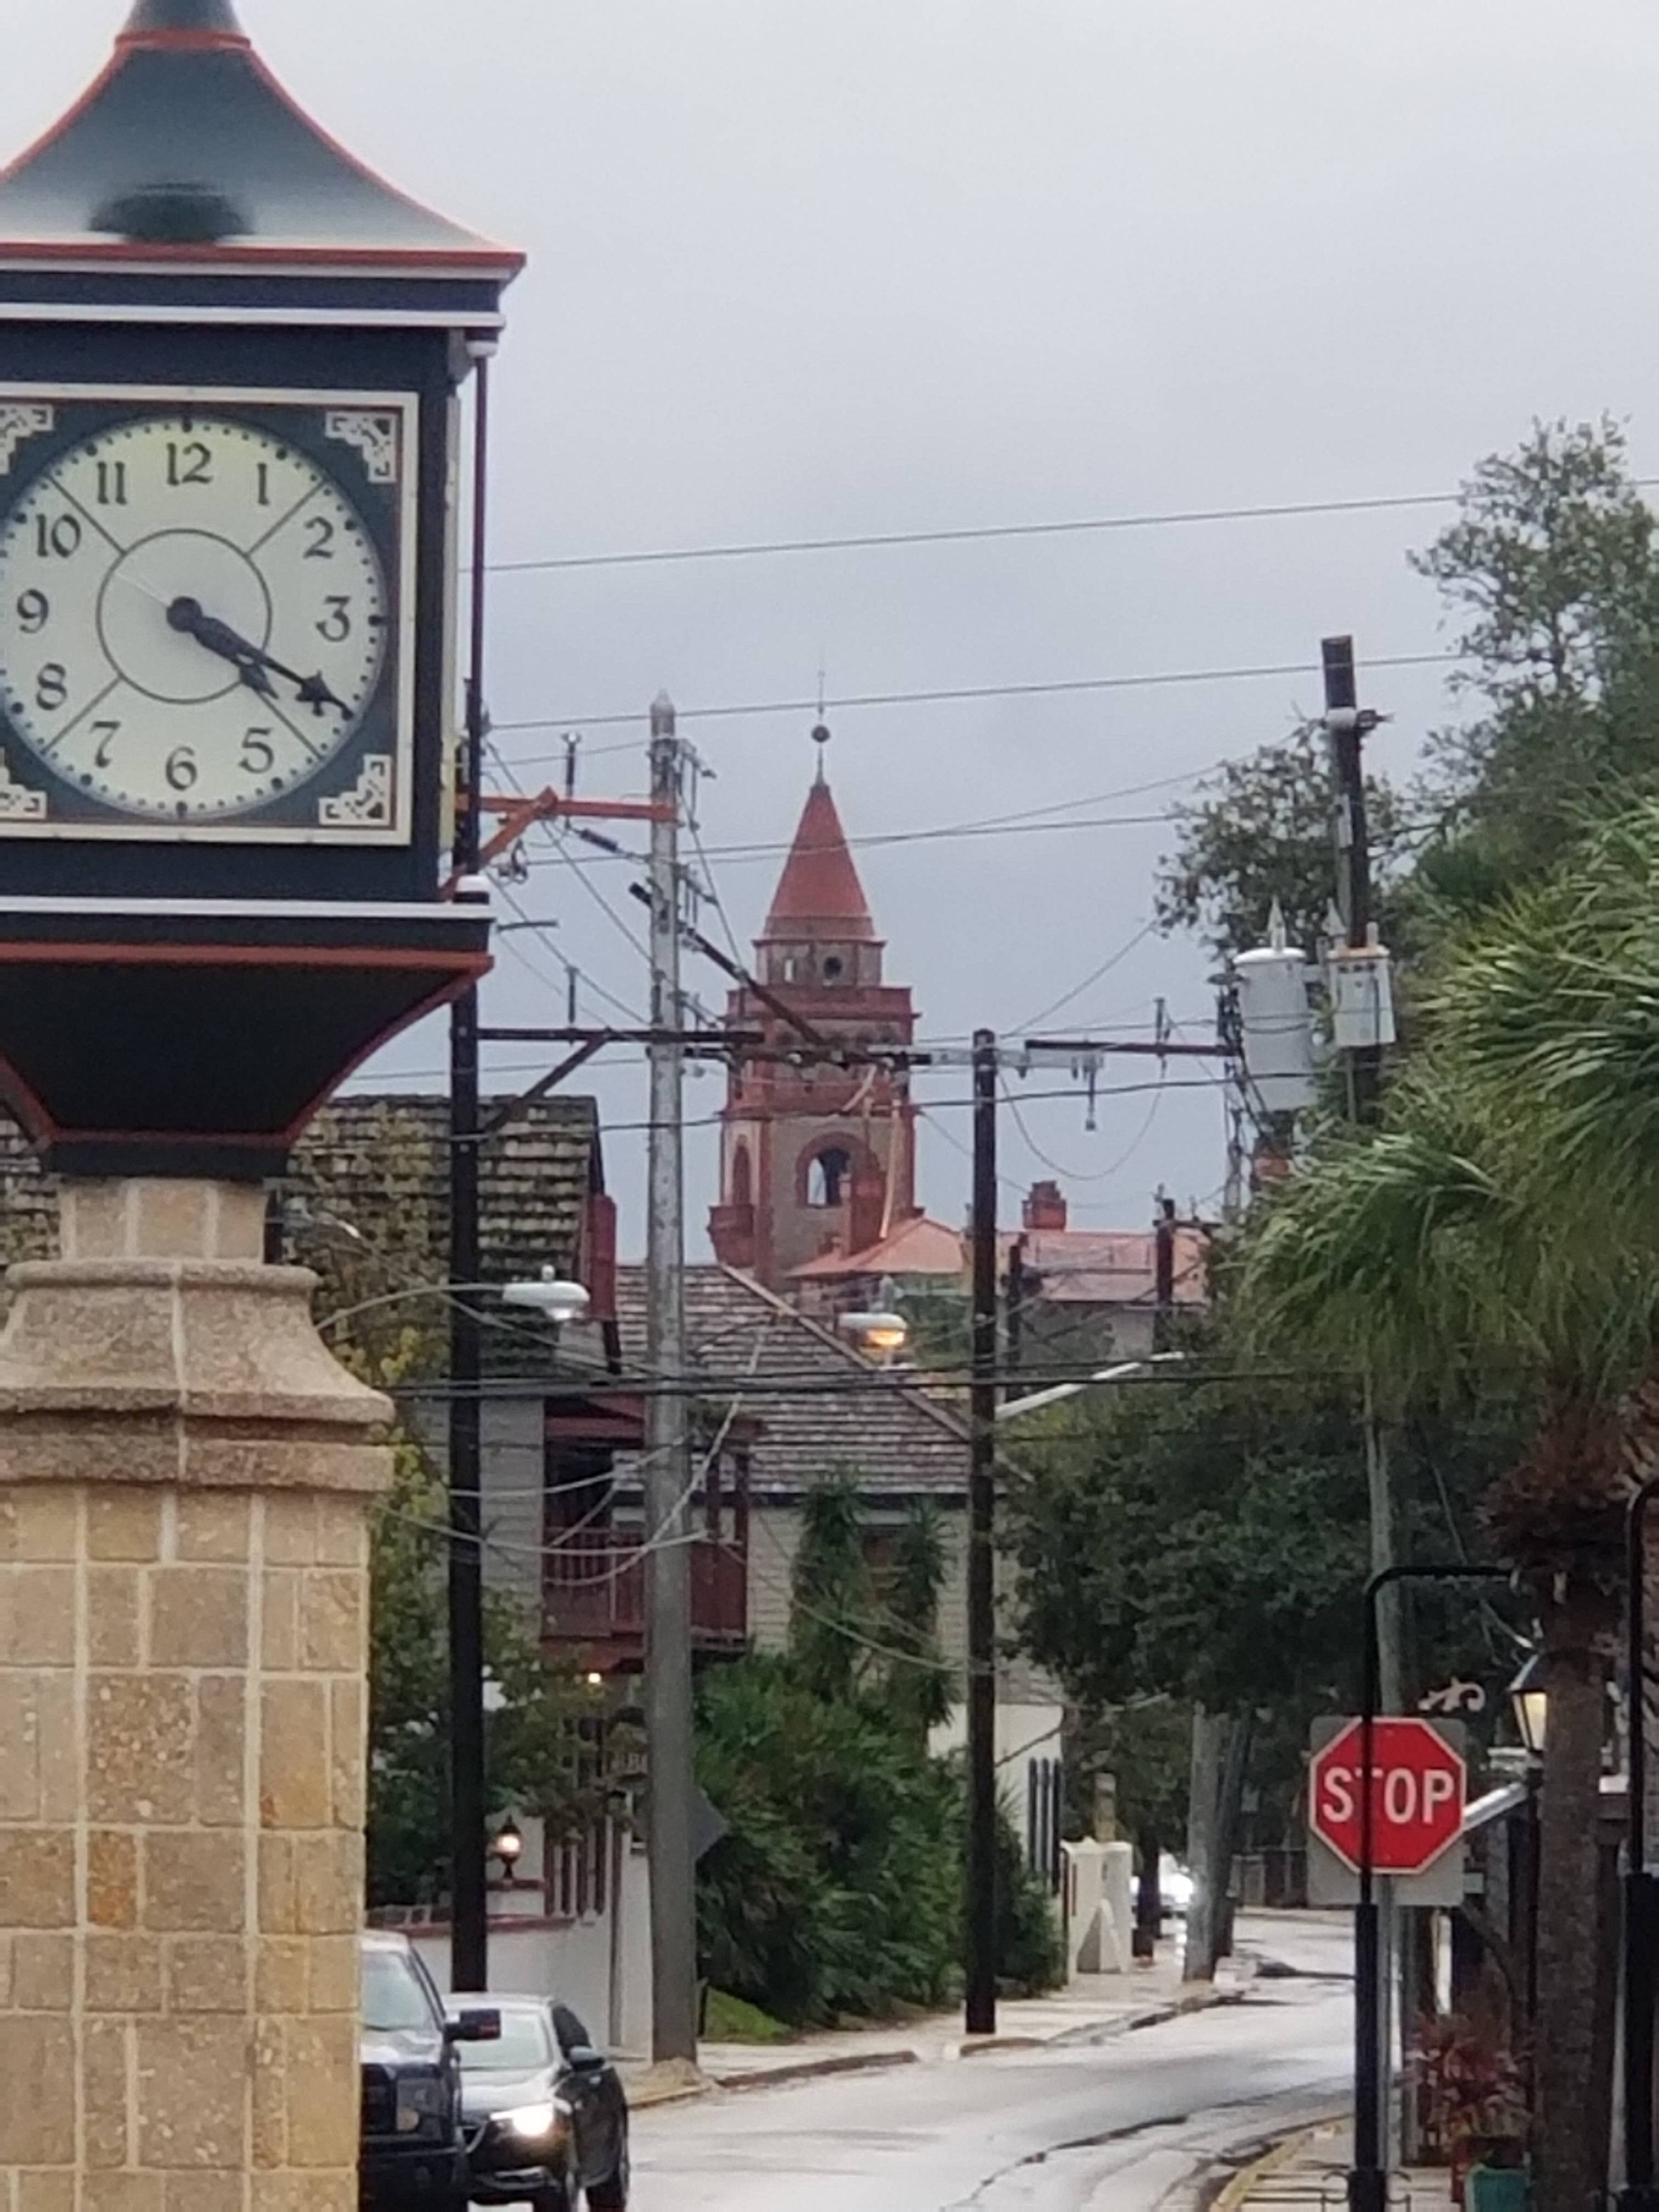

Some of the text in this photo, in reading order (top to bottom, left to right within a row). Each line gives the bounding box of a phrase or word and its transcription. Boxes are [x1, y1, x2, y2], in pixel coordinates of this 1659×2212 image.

[95, 460, 128, 506] 11
[166, 442, 213, 487] 12
[256, 462, 270, 506] 1
[35, 513, 82, 558] 10
[303, 516, 334, 559] 2
[16, 588, 49, 634] 9
[315, 595, 351, 642] 3
[35, 662, 67, 712] 8
[91, 720, 121, 769] 7
[238, 726, 275, 774] 5
[165, 746, 198, 792] 6
